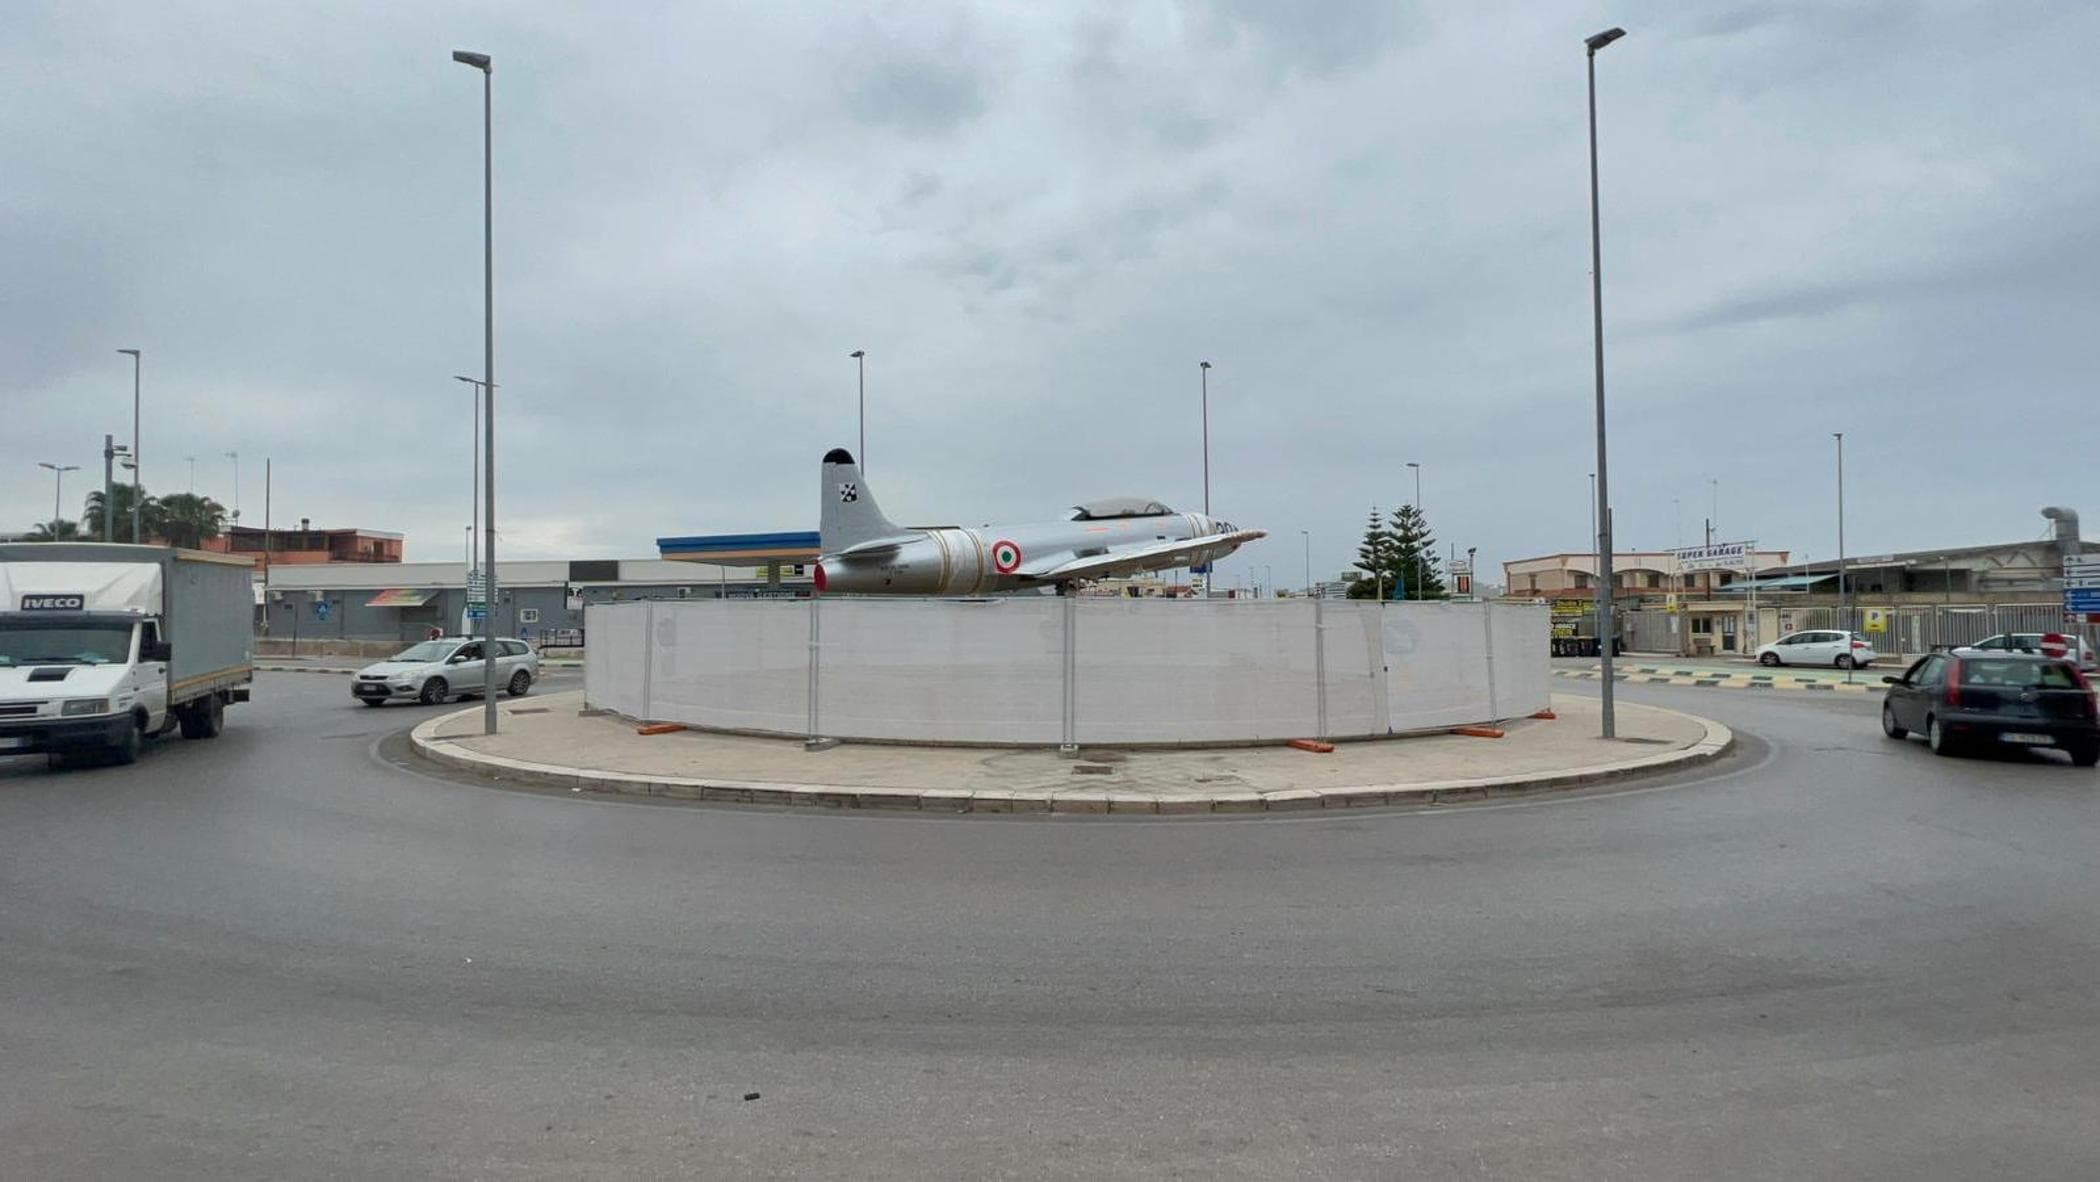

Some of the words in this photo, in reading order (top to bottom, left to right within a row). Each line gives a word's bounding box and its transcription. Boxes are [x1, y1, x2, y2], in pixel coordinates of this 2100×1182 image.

[1677, 550, 1703, 560] SUPER
[1706, 546, 1743, 557] GARAGE
[23, 598, 80, 609] IVECO
